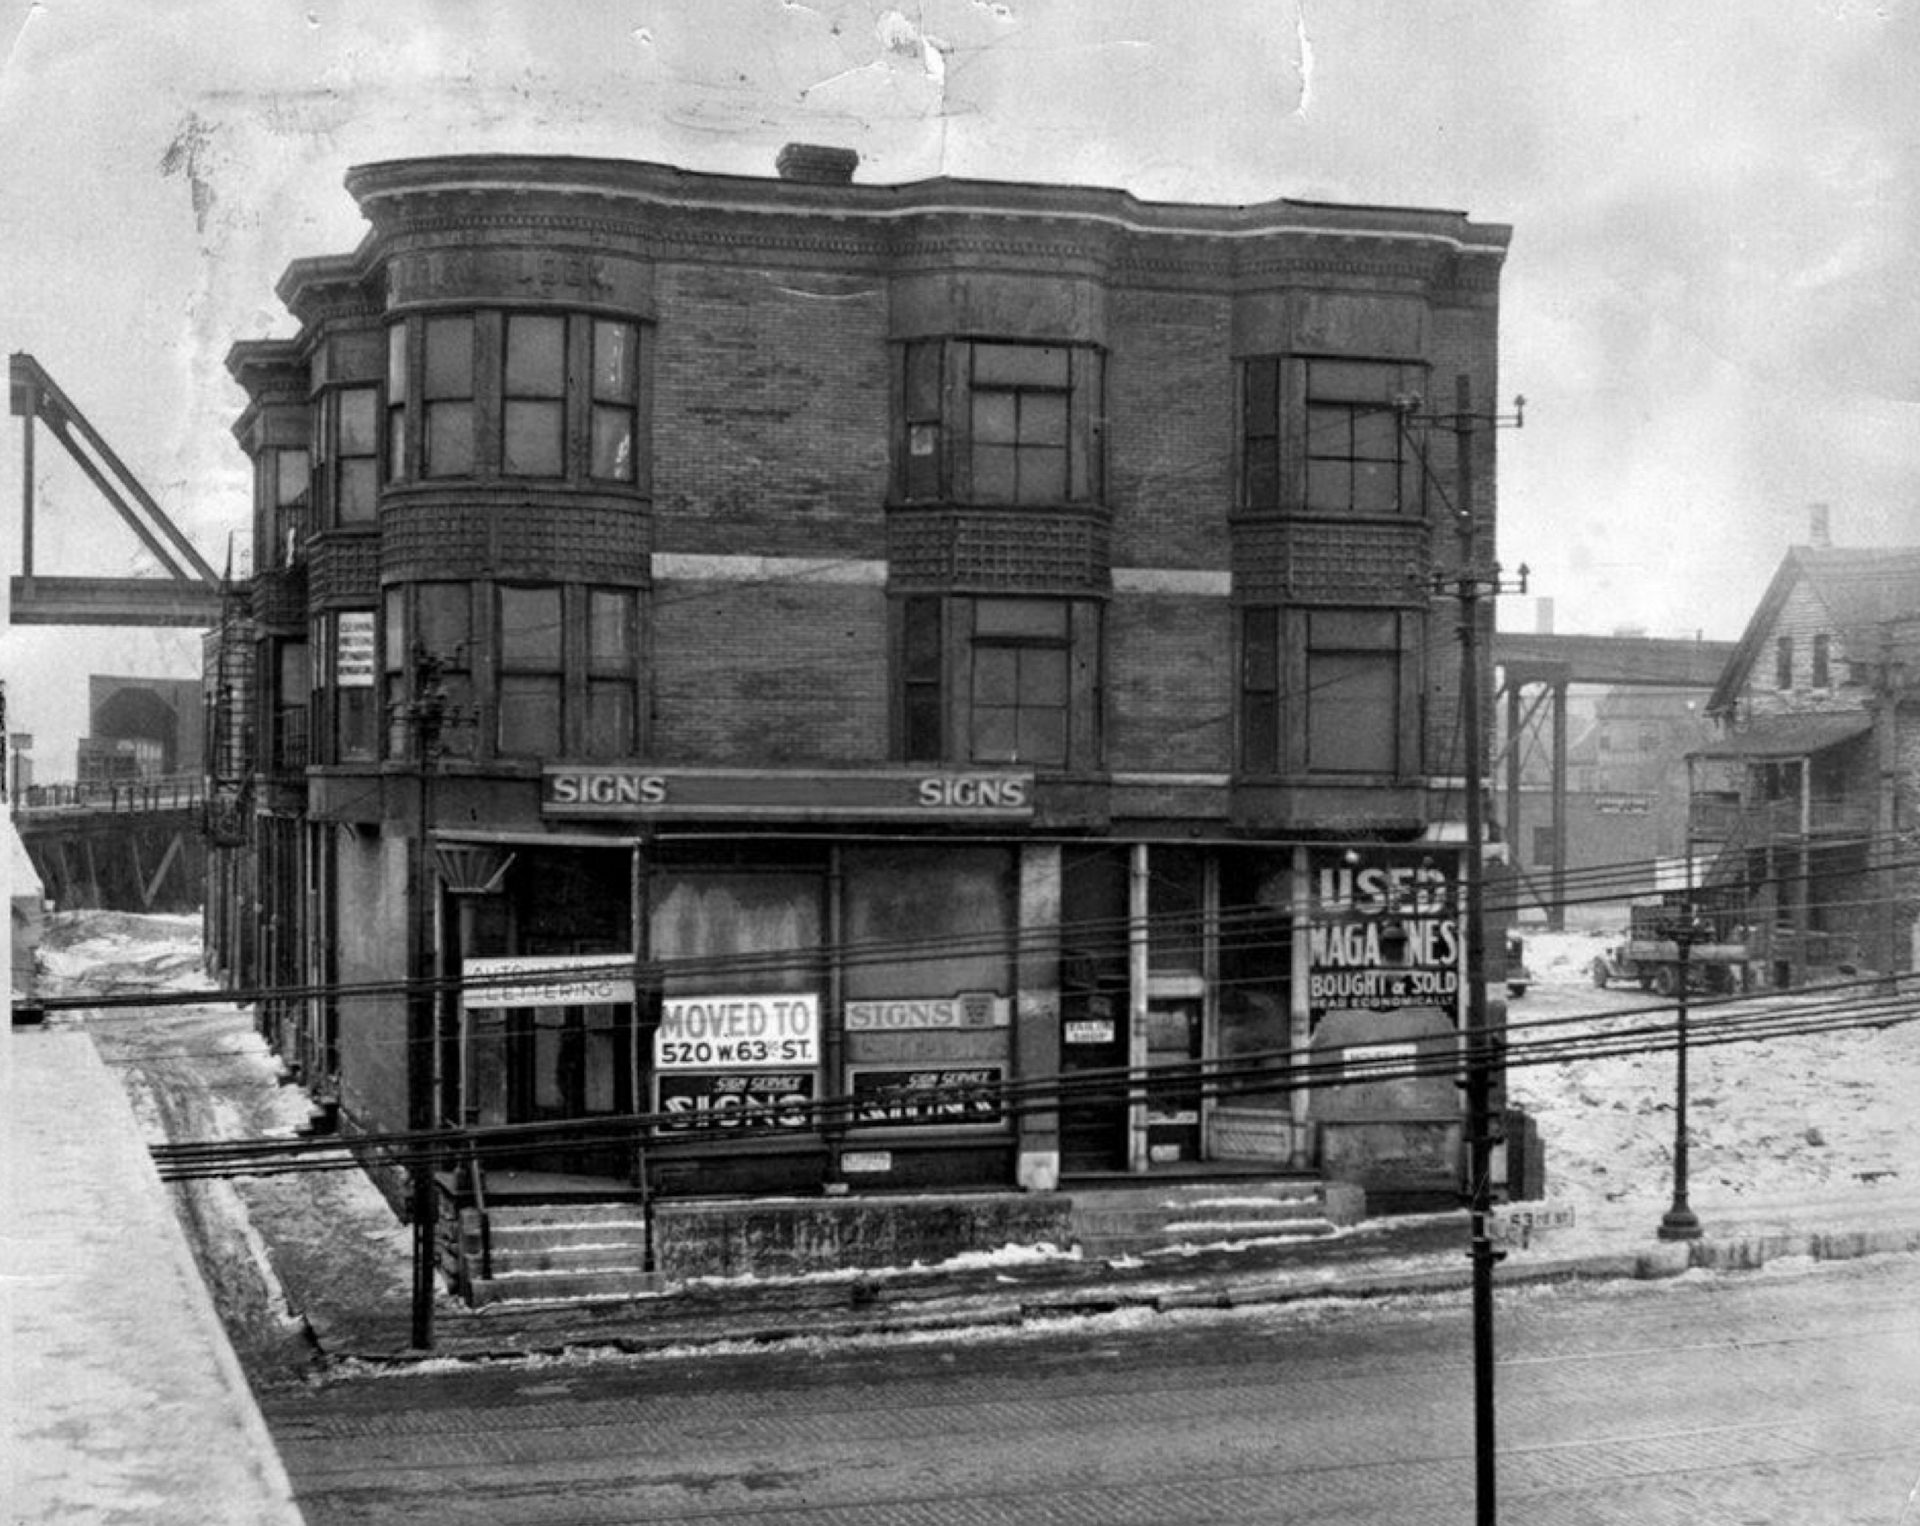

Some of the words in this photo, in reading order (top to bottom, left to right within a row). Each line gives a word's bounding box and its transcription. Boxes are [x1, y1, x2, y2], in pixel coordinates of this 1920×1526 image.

[553, 775, 666, 803] SIGNS
[919, 778, 1026, 807] SIGNS
[1320, 868, 1446, 915] USED
[1309, 919, 1458, 968] MAGANES
[486, 981, 613, 1001] LETTERING
[1311, 972, 1387, 998] BOUGHT
[1411, 971, 1458, 994] SOLD
[660, 1003, 766, 1039] MOVED
[773, 1001, 810, 1036] TO
[850, 1001, 953, 1028] SIGNS
[662, 1042, 712, 1063] 520
[664, 1094, 807, 1128] SIGNS
